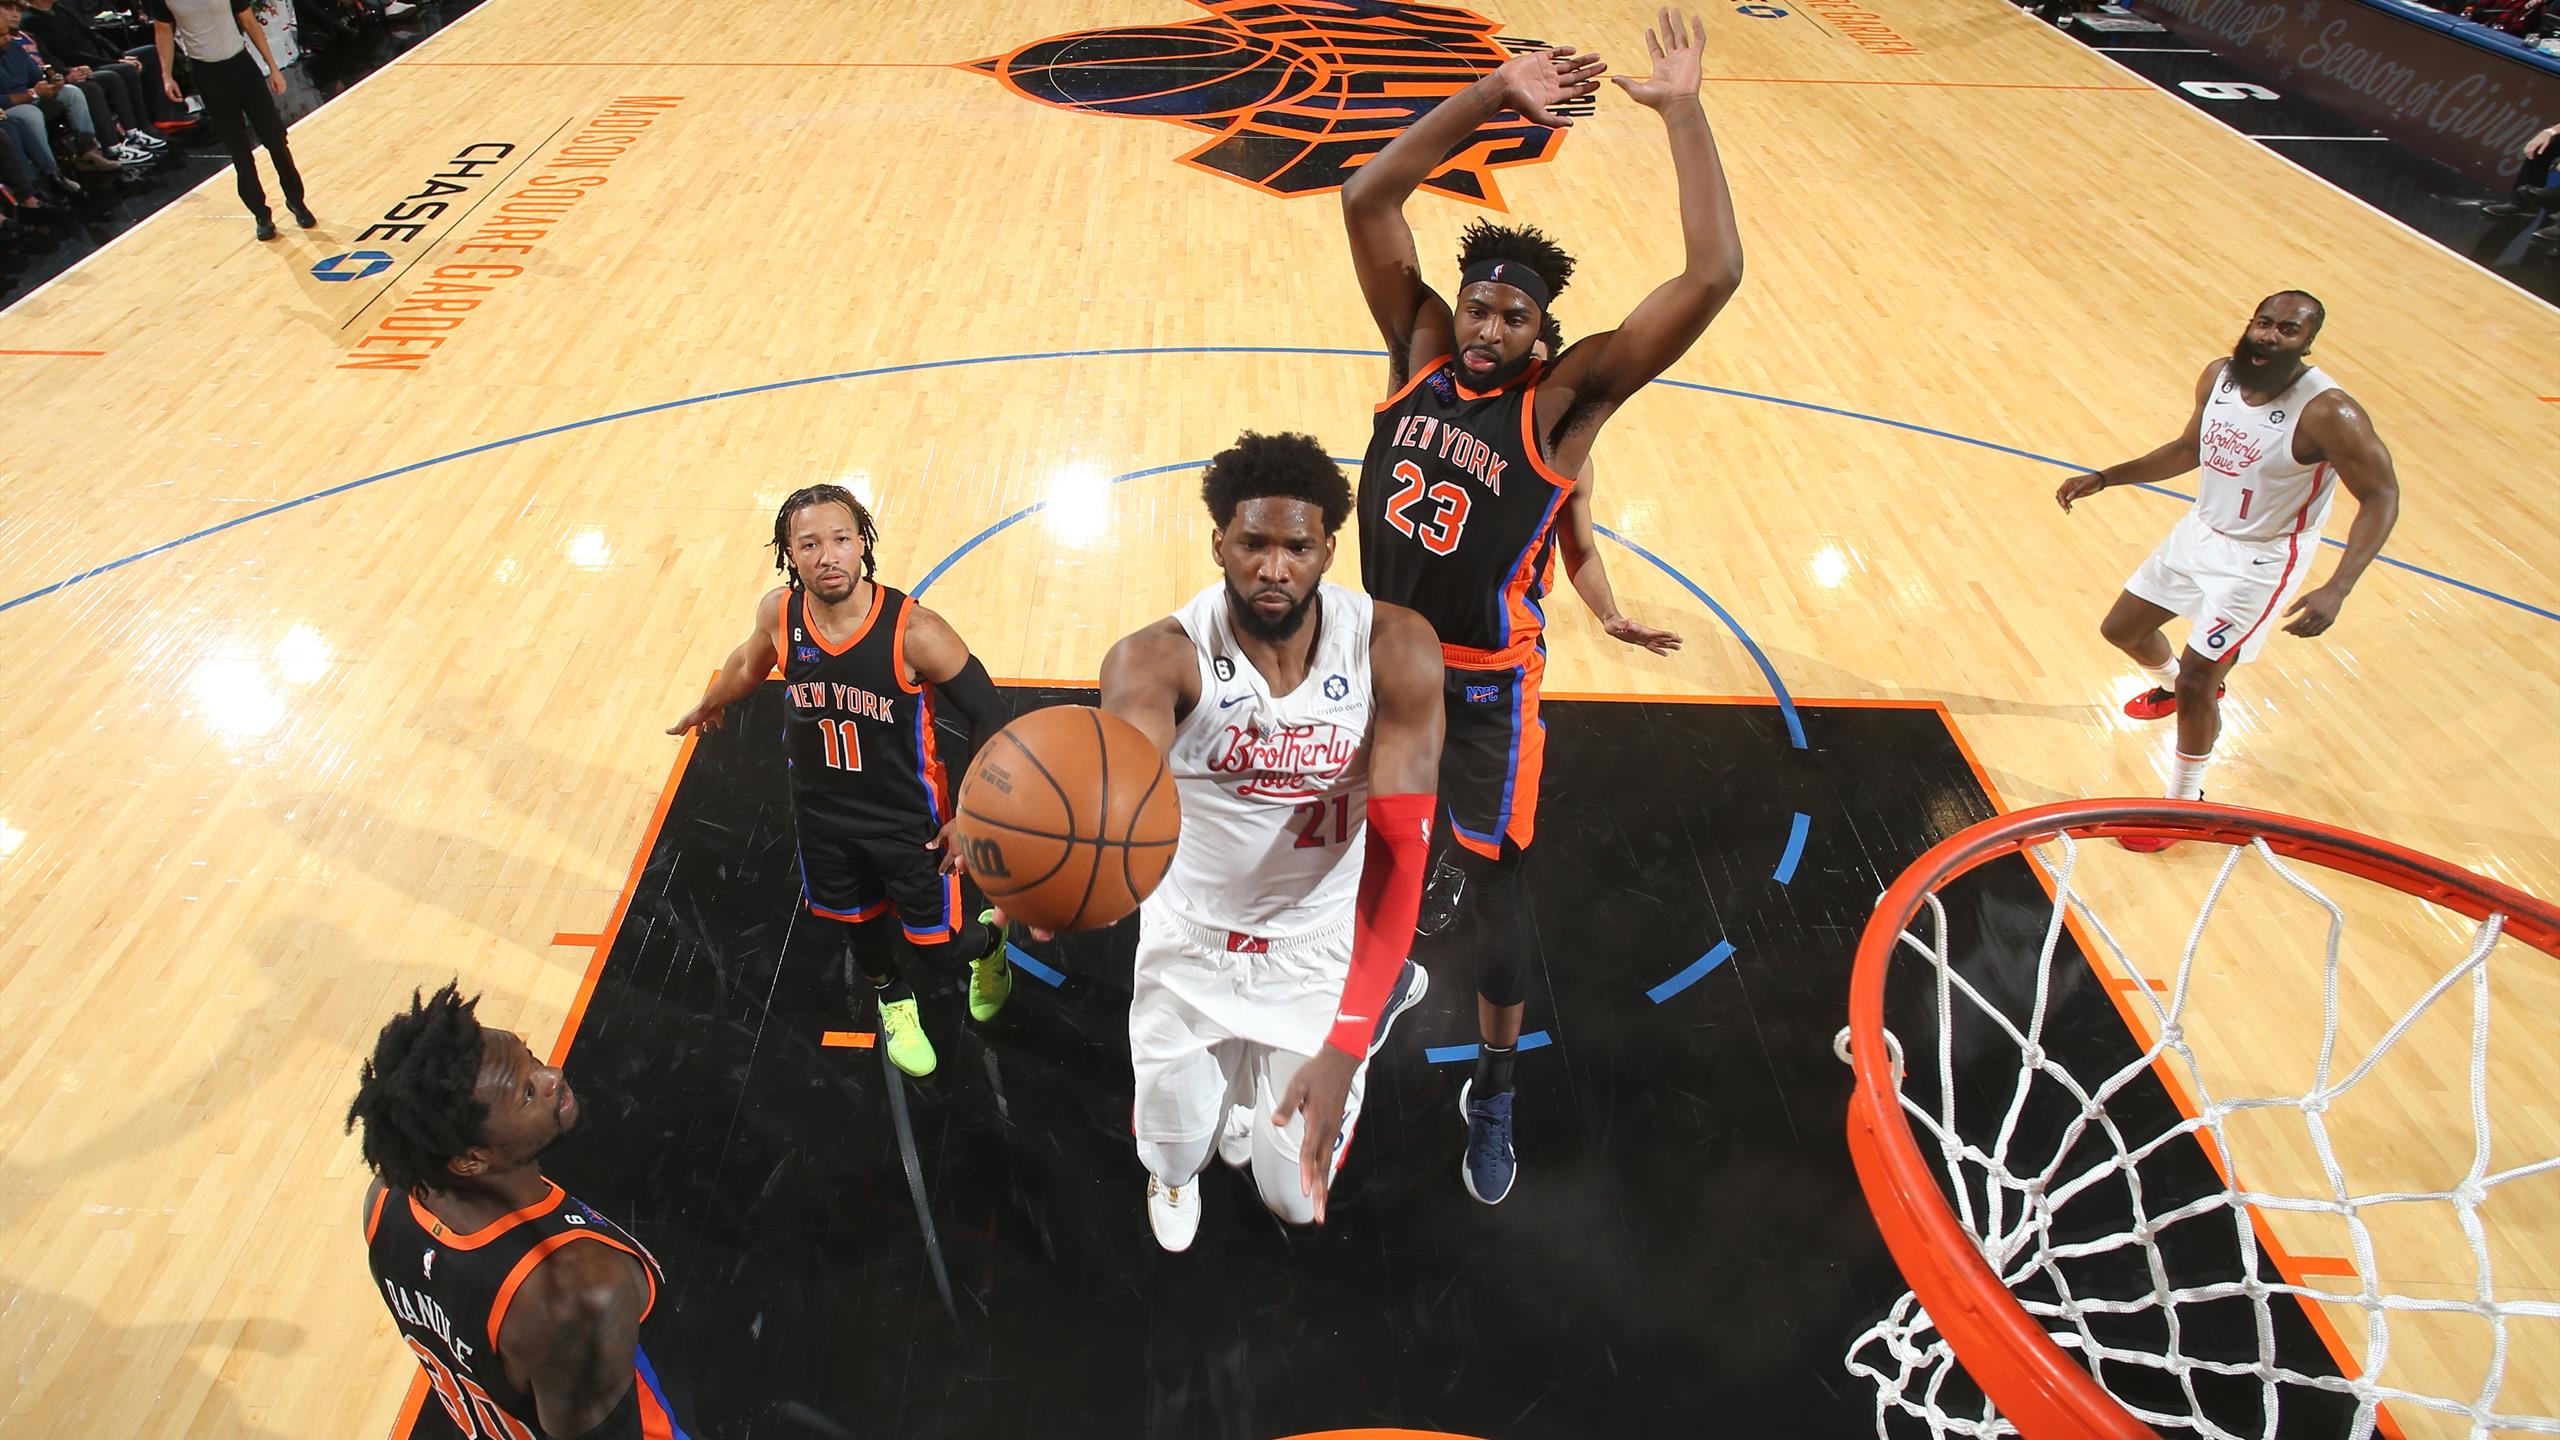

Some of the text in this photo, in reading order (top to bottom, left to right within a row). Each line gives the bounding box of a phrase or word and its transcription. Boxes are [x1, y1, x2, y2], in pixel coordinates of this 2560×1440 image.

[1820, 12, 1925, 55] GARDEN
[2297, 18, 2418, 107] Season
[2405, 79, 2445, 118] of
[2178, 81, 2281, 100] 6
[353, 143, 516, 243] CHASE
[335, 96, 685, 371] MADISON SQUARE GARDEN
[1392, 415, 1509, 497] NEW YORK
[2204, 446, 2240, 477] Love
[1384, 459, 1472, 556] 23
[2238, 488, 2254, 520] 1
[794, 627, 803, 642] 6
[1216, 658, 1233, 681] 6
[787, 682, 895, 724] NEW YORK
[1317, 702, 1363, 716] crypto.com
[1466, 685, 1499, 703] NYC
[818, 718, 862, 772] 11
[1293, 794, 1350, 849] 21
[564, 1214, 587, 1225] 6
[385, 1278, 473, 1374] RANDLE
